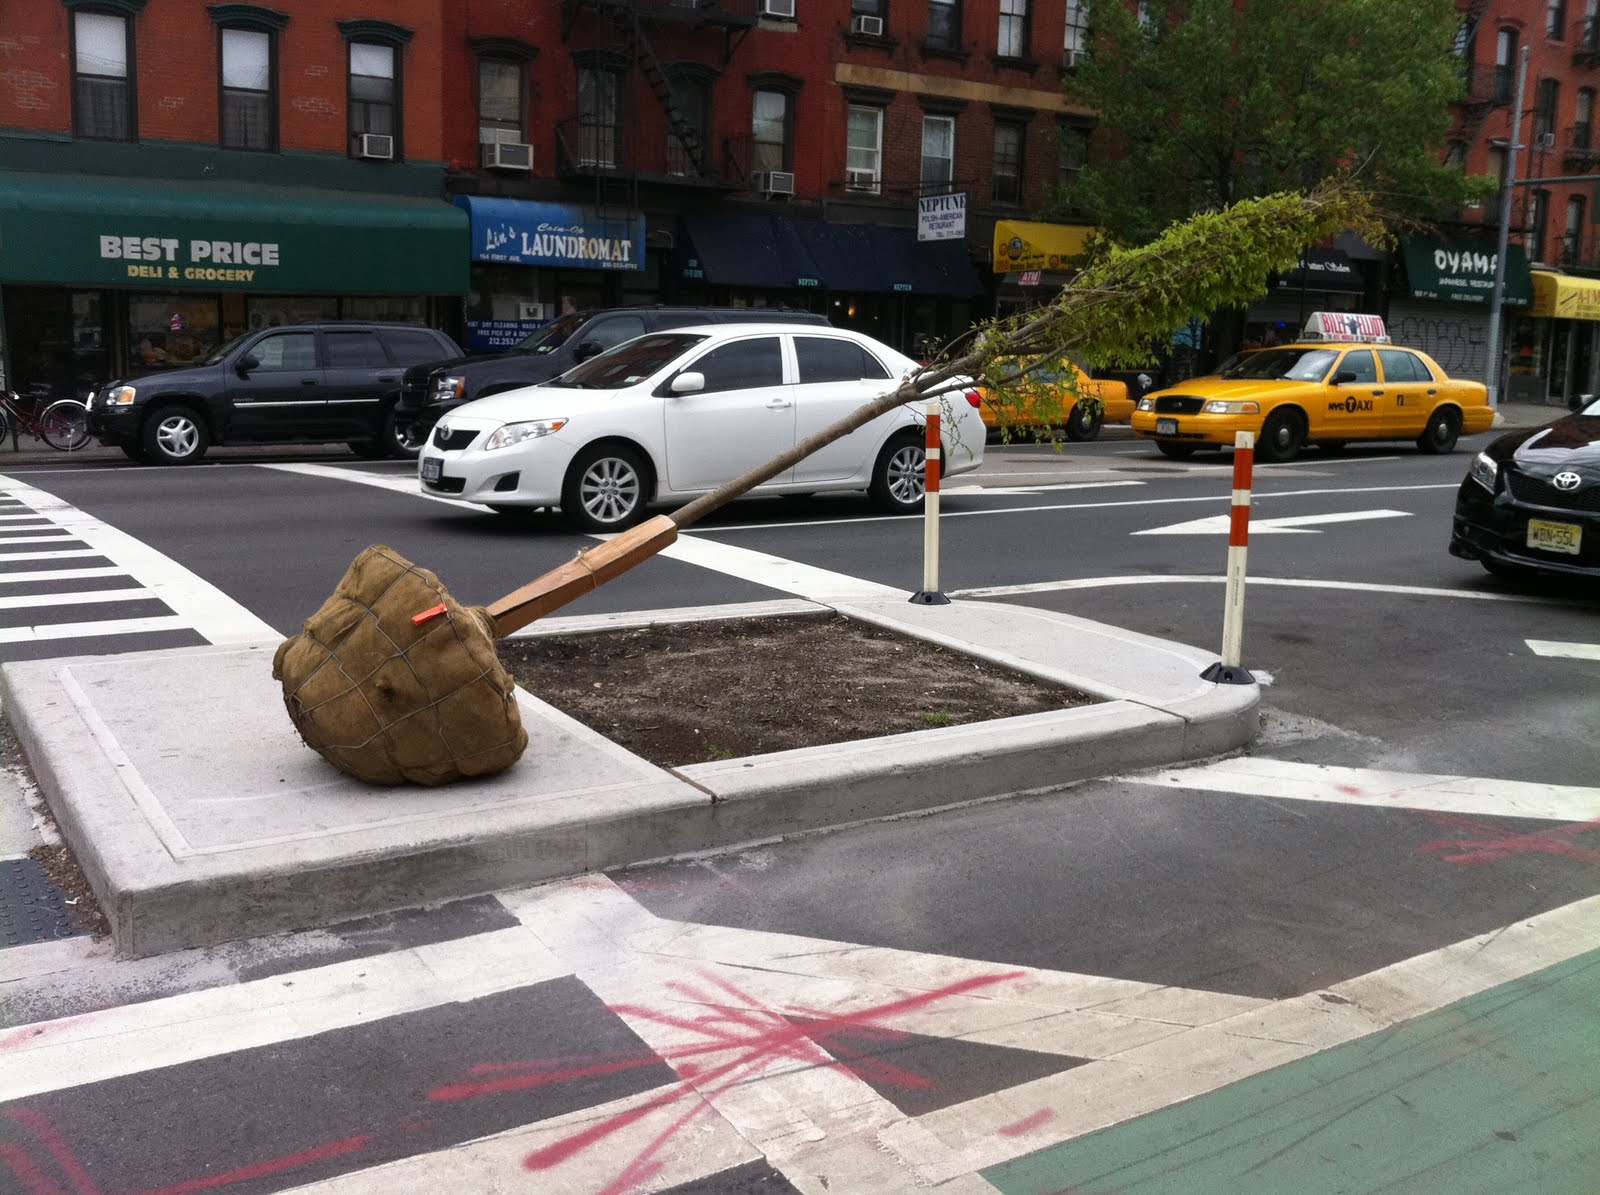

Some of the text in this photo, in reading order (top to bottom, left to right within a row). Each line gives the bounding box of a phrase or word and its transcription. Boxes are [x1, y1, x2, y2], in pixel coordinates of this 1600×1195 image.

[920, 195, 966, 212] NEPTUNE
[100, 235, 279, 266] BEST PRICE
[521, 232, 632, 262] LAUNDROMAT
[127, 264, 255, 282] DELI & GROCERY
[1021, 272, 1038, 282] ATM
[1321, 313, 1385, 337] BILLY ELLIOT
[1328, 402, 1345, 411] NYC
